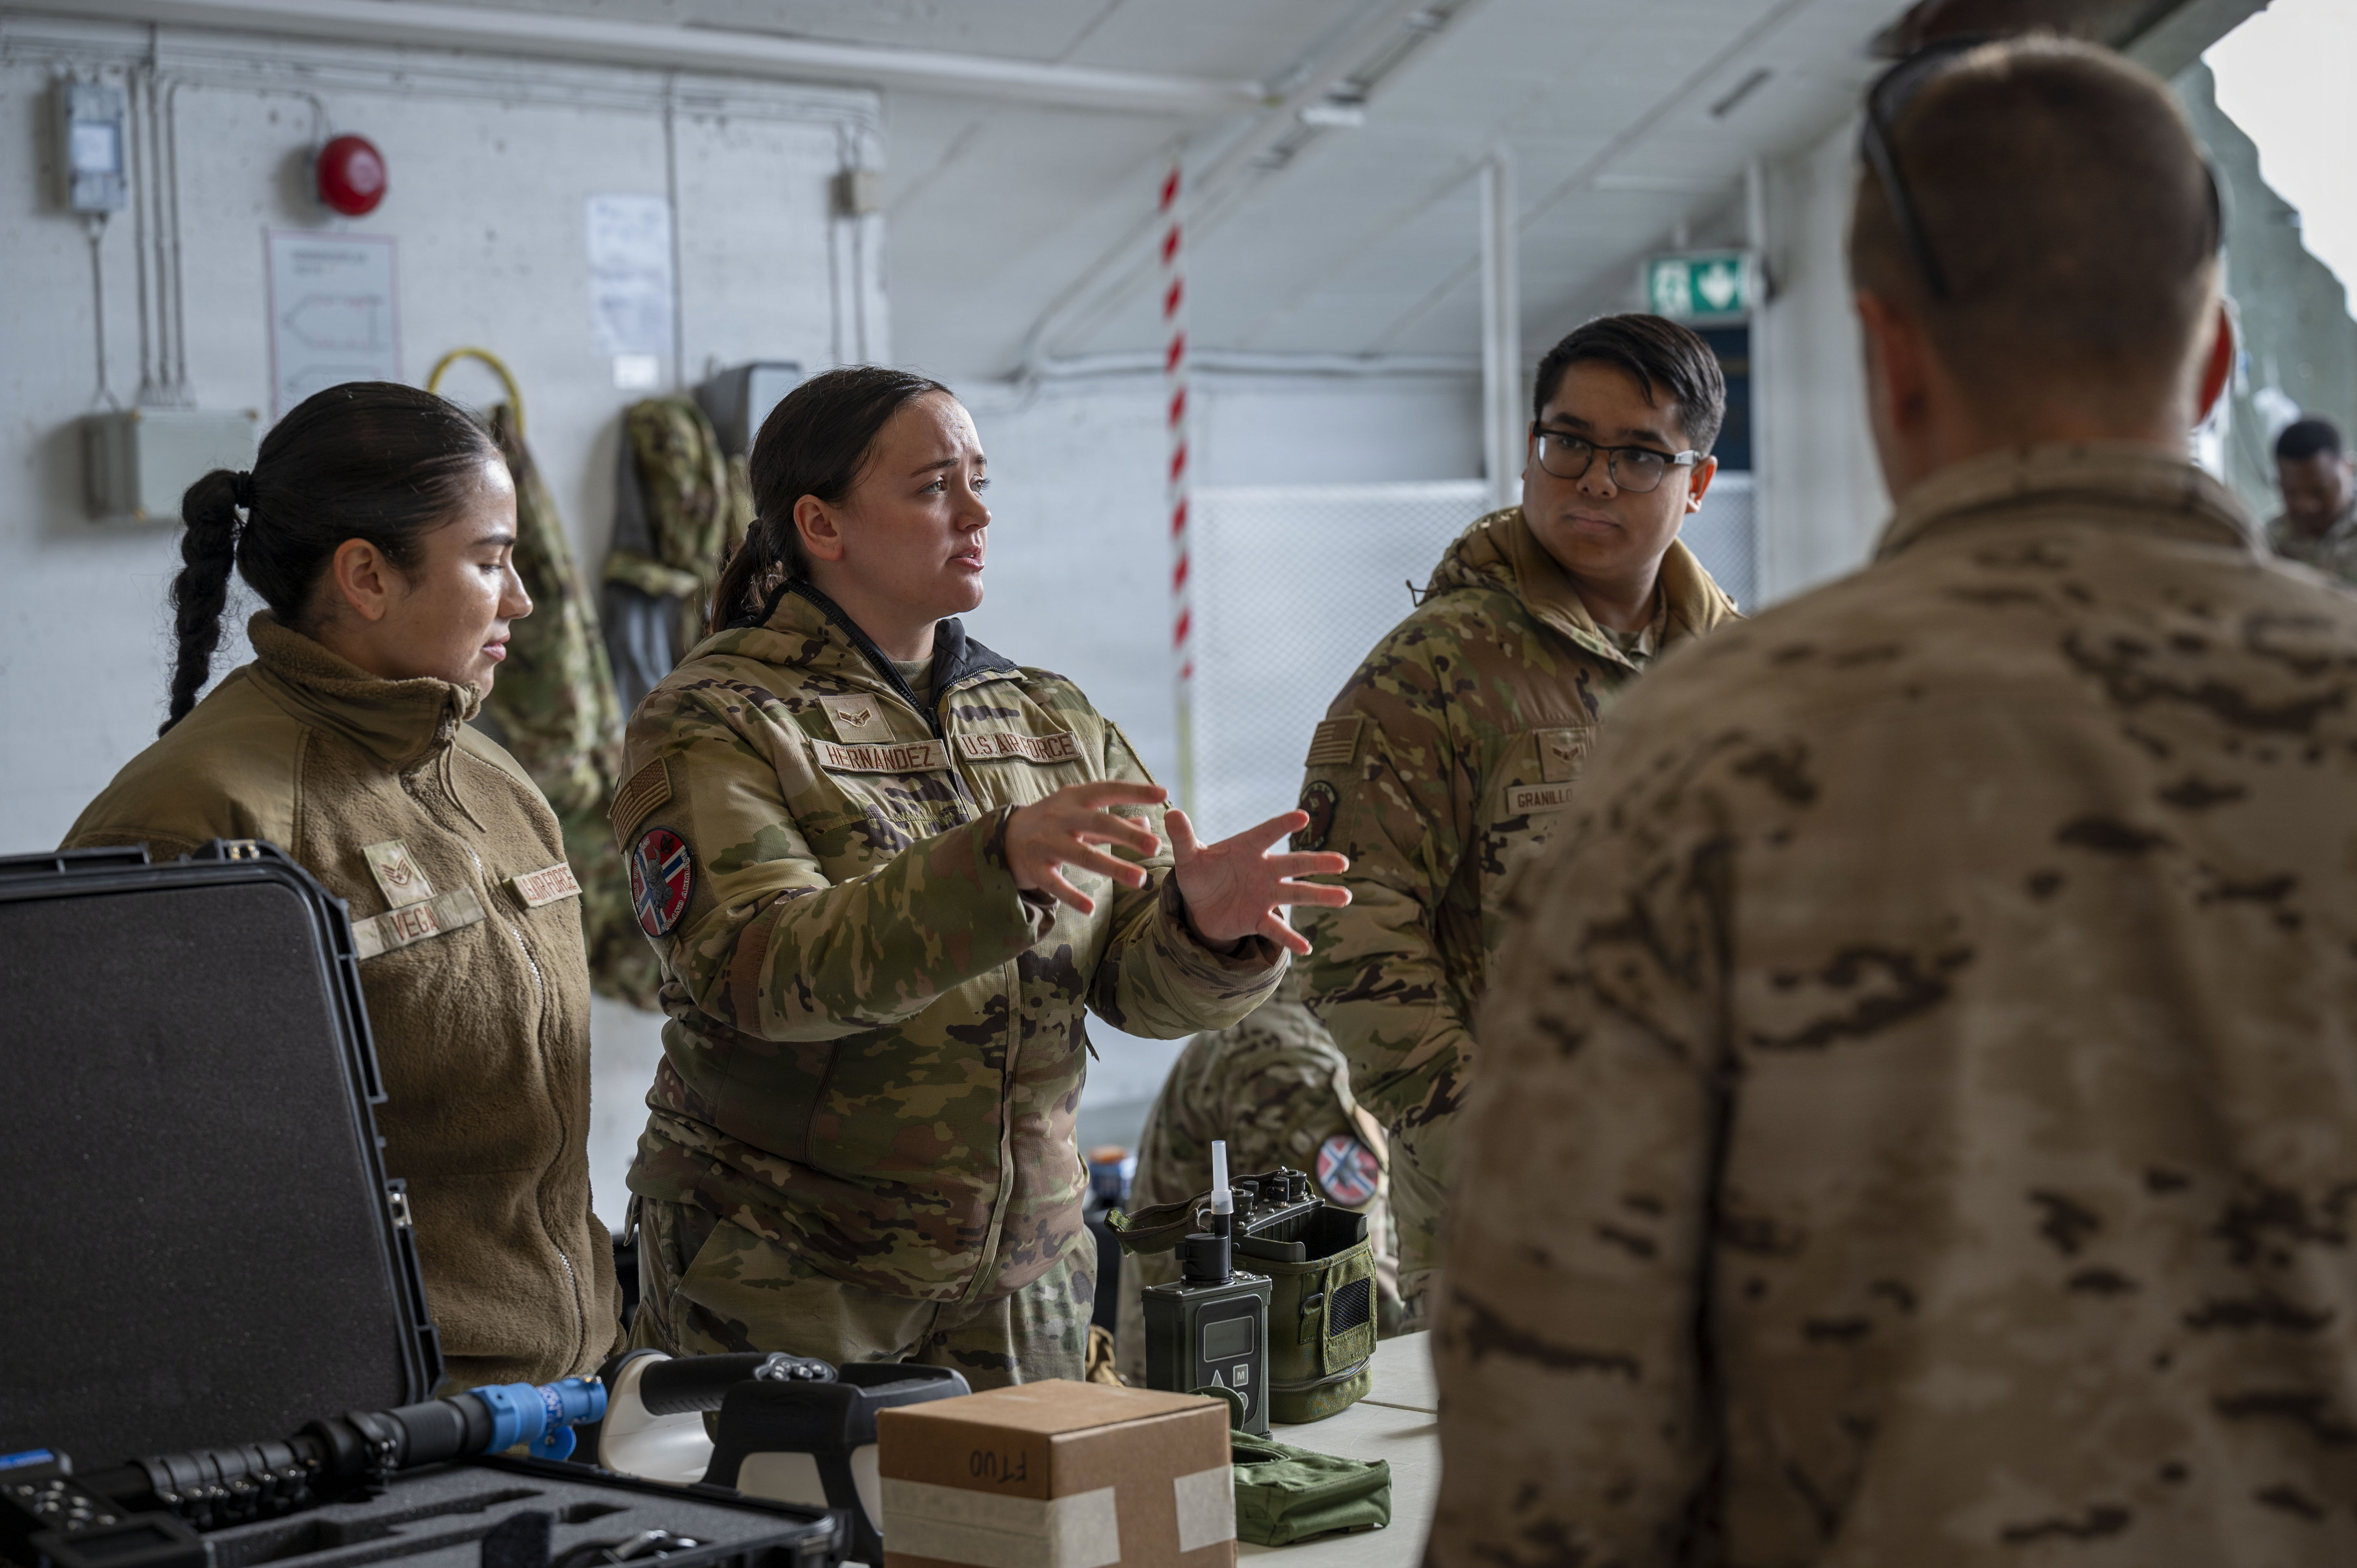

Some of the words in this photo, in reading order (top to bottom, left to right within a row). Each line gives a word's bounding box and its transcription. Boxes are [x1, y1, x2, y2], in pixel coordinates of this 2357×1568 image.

[825, 745, 935, 770] HERNANDEZ
[961, 735, 997, 755] U.S.
[995, 733, 1026, 755] AIR
[1019, 735, 1074, 759] FORCE
[1517, 788, 1573, 808] GRANILLO
[541, 866, 577, 895] FORCE
[633, 882, 643, 913] TOXIC
[638, 836, 650, 855] 2025
[680, 849, 690, 898] AIRBASE
[390, 905, 440, 941] VEGA
[1237, 1370, 1245, 1381] M
